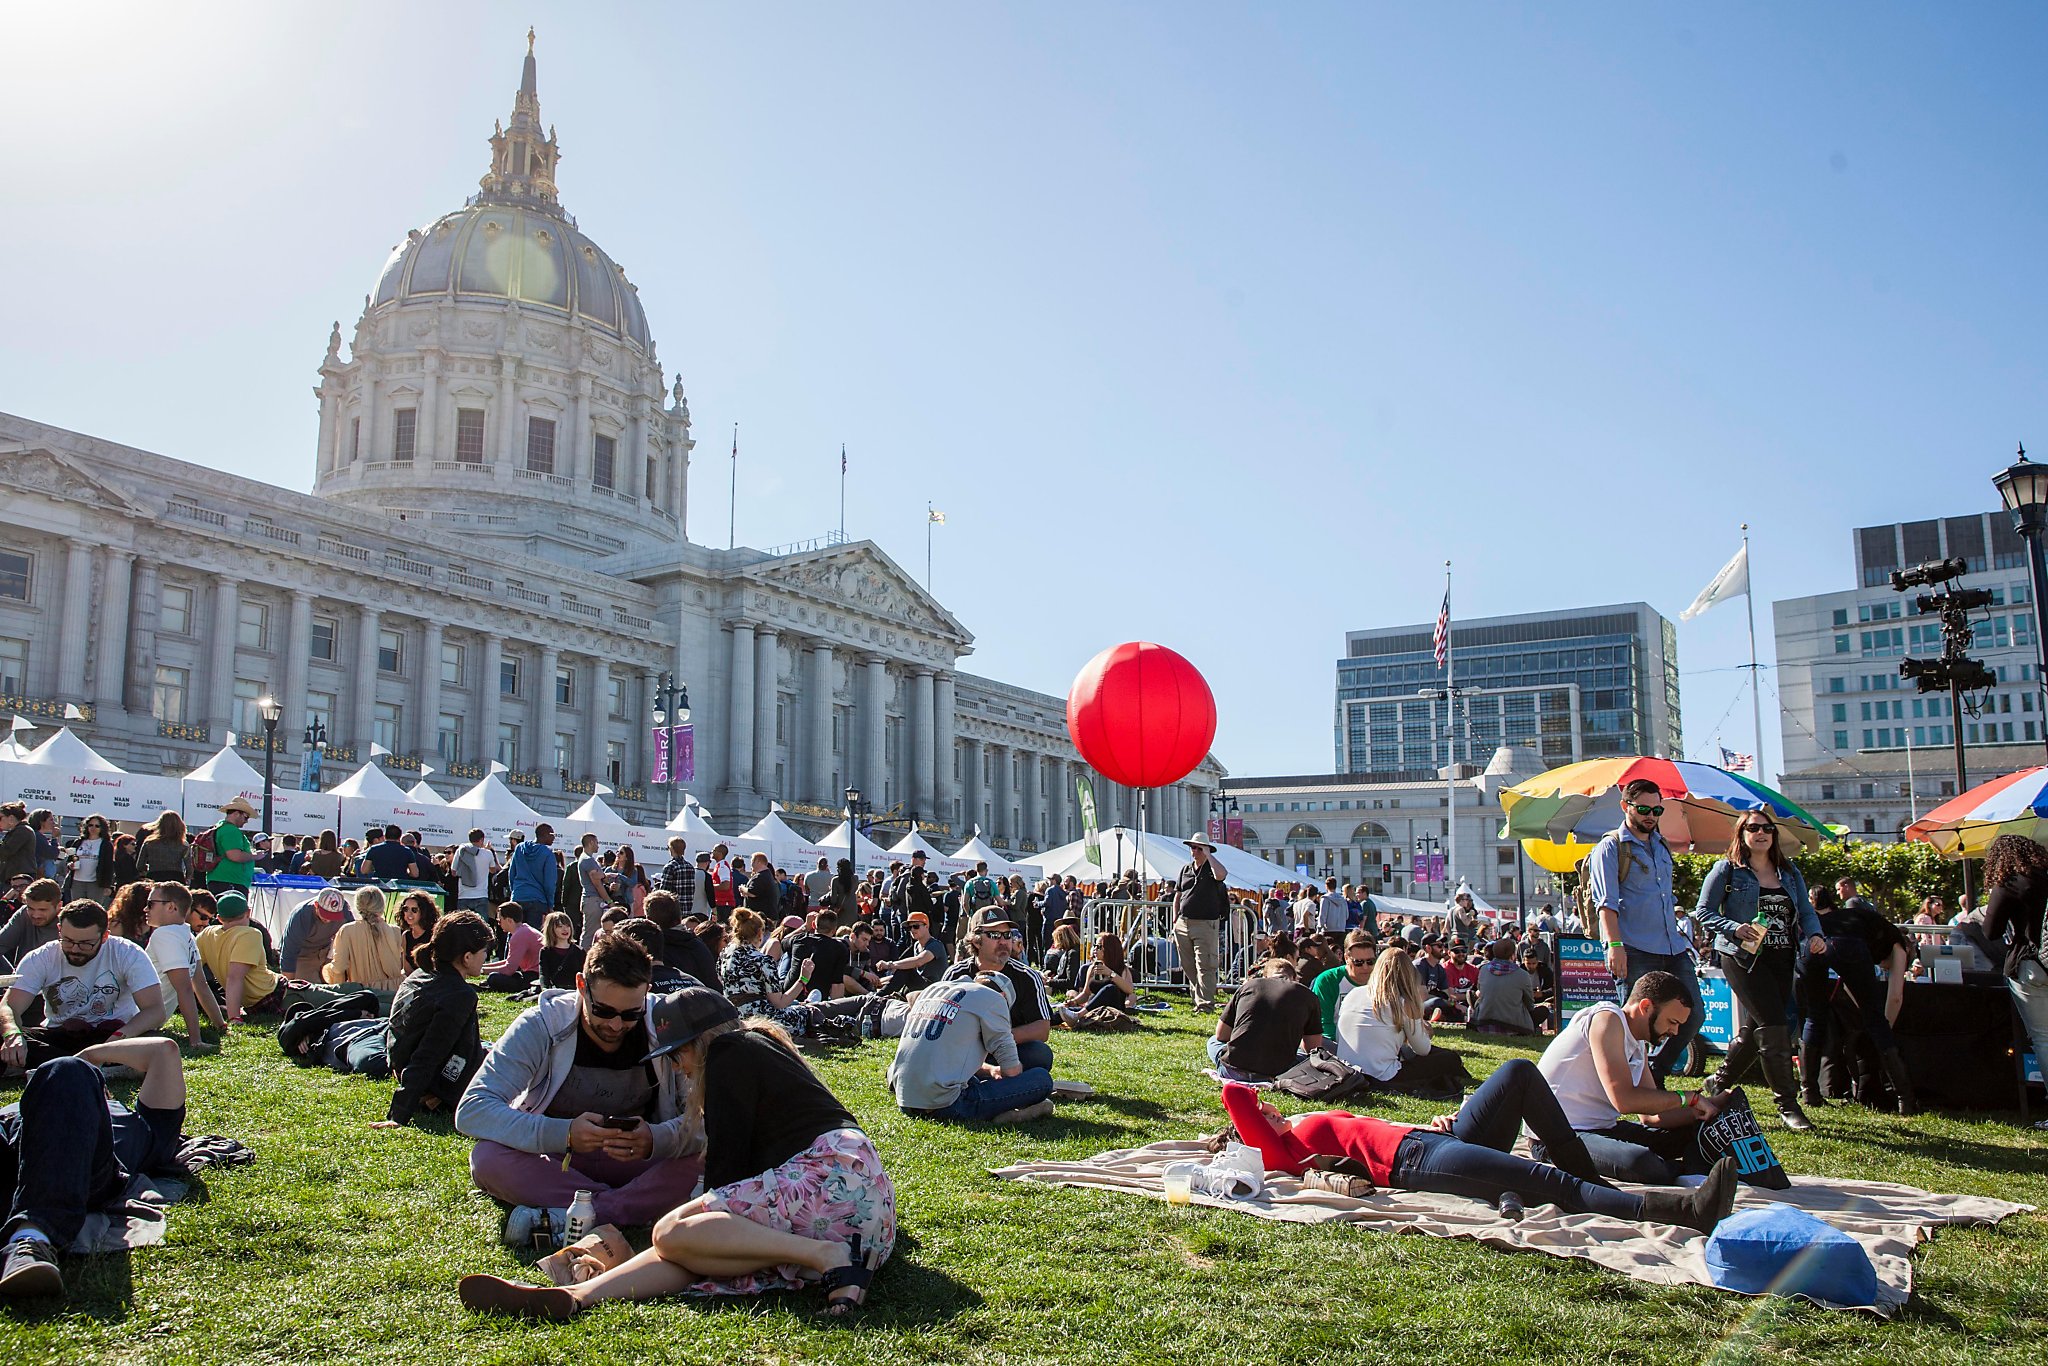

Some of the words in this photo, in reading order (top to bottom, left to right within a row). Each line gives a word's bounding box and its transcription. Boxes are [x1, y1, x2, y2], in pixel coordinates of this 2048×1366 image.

[659, 728, 669, 783] OPERA
[1212, 820, 1220, 843] PERA
[1561, 945, 1579, 953] pop
[1709, 1001, 1729, 1011] pops
[1699, 1025, 1724, 1034] avors
